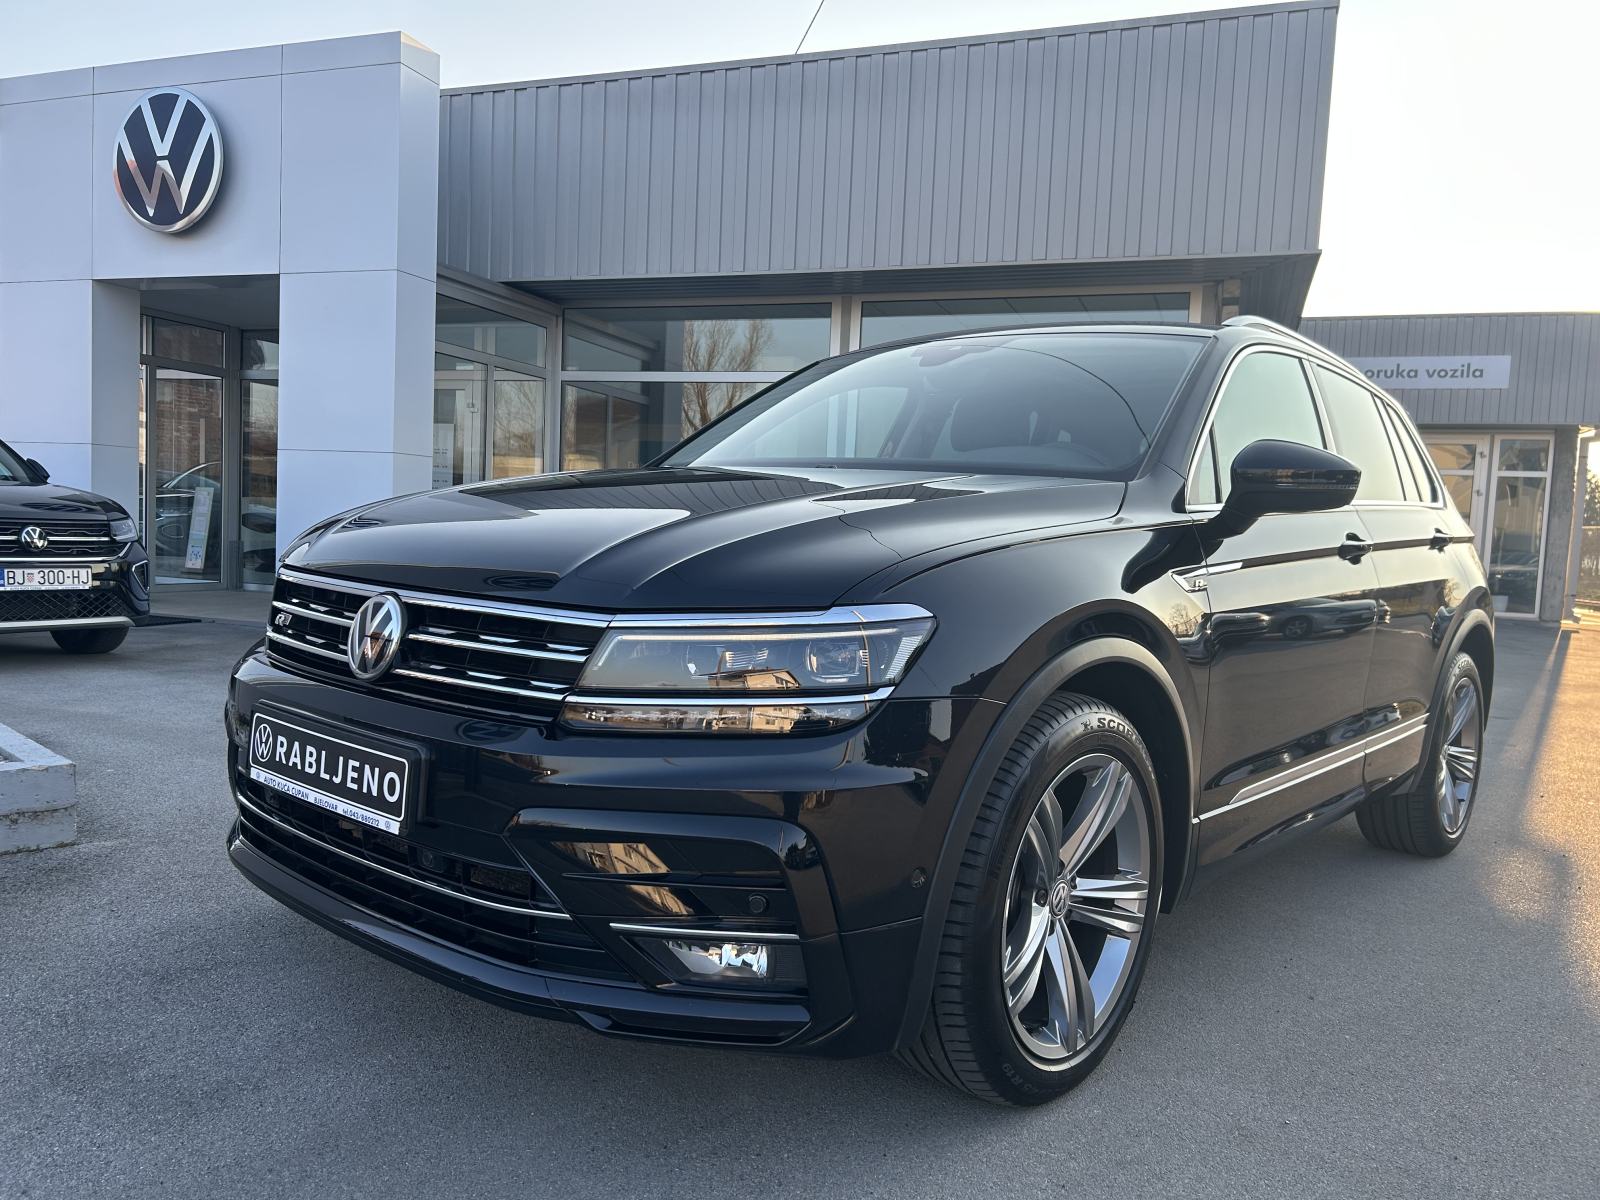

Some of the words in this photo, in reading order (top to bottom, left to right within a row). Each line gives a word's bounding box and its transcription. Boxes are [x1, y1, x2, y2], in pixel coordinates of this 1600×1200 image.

[1364, 363, 1418, 379] oruka
[1426, 362, 1484, 378] vozila
[7, 571, 25, 585] BJ
[38, 570, 89, 585] 300-HJ
[275, 735, 400, 803] RABLJENO
[264, 776, 277, 786] AUTO
[314, 796, 338, 811] BJELOVAR
